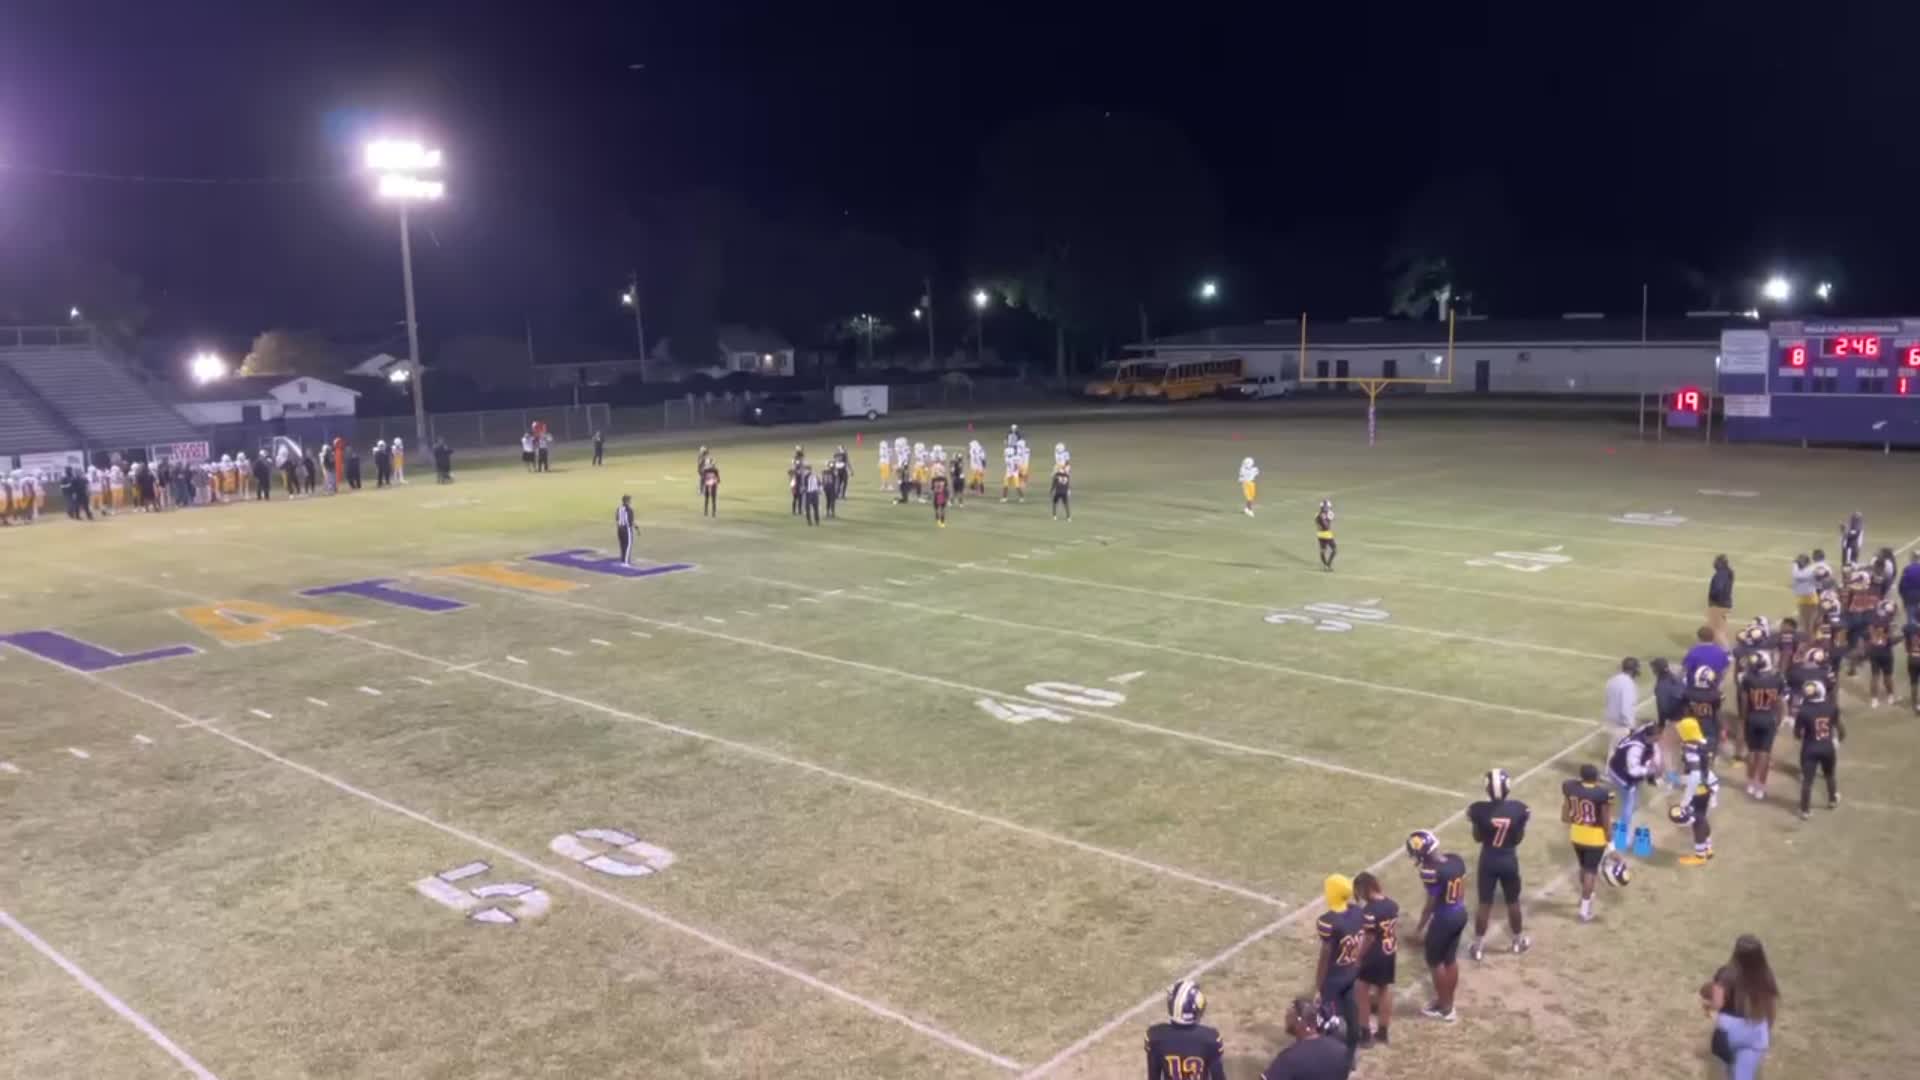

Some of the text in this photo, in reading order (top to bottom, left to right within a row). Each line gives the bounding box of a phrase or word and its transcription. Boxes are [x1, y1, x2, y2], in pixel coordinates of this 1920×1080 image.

[1792, 348, 1805, 366] 8
[1678, 392, 1698, 410] 19
[975, 681, 1127, 724] 40
[1491, 817, 1511, 847] 7
[414, 828, 674, 923] 50
